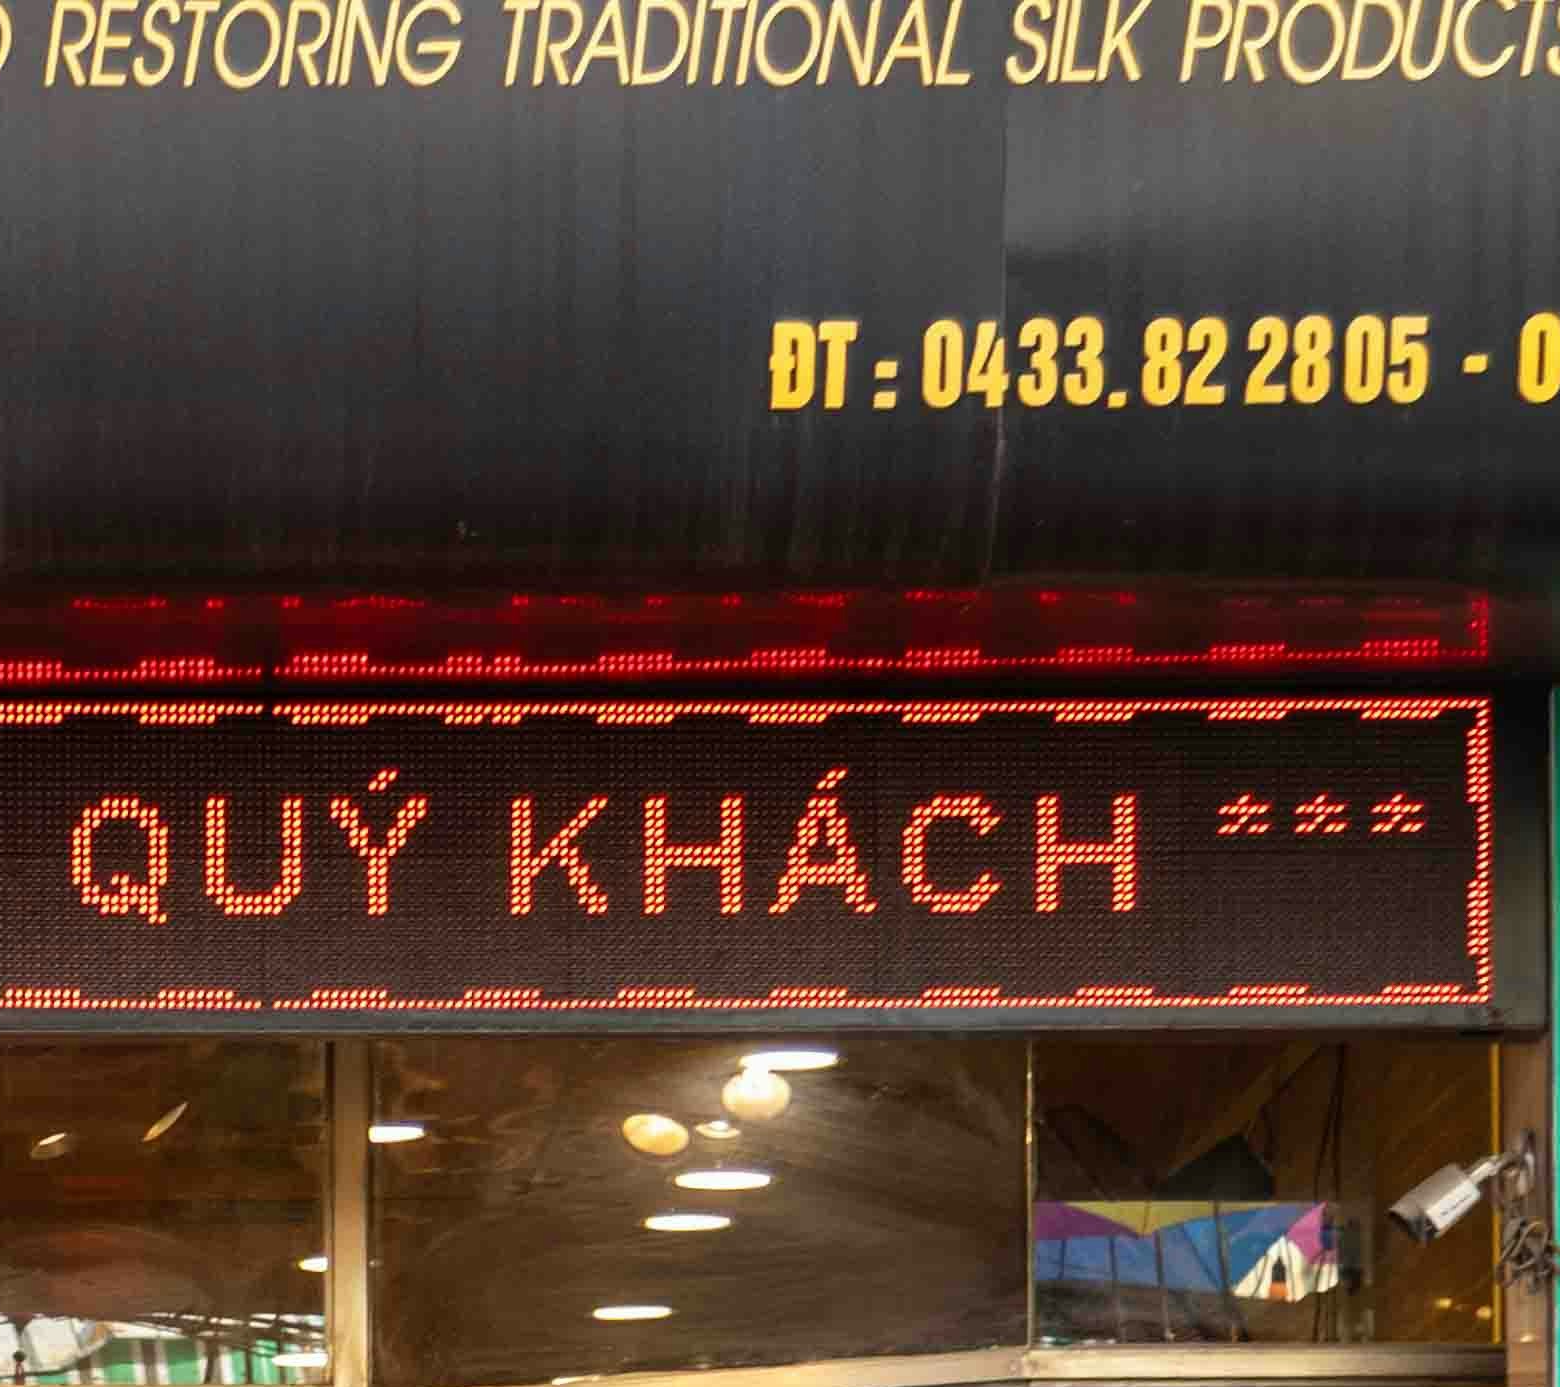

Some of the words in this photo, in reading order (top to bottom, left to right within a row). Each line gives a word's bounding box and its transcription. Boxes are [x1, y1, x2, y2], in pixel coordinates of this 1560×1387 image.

[43, 0, 463, 90] RESTORING
[502, 0, 972, 88] TRADITIONAL
[1004, 0, 1153, 86] SILK
[69, 769, 428, 925] QUÝ
[509, 768, 1138, 916] KHÁCH
